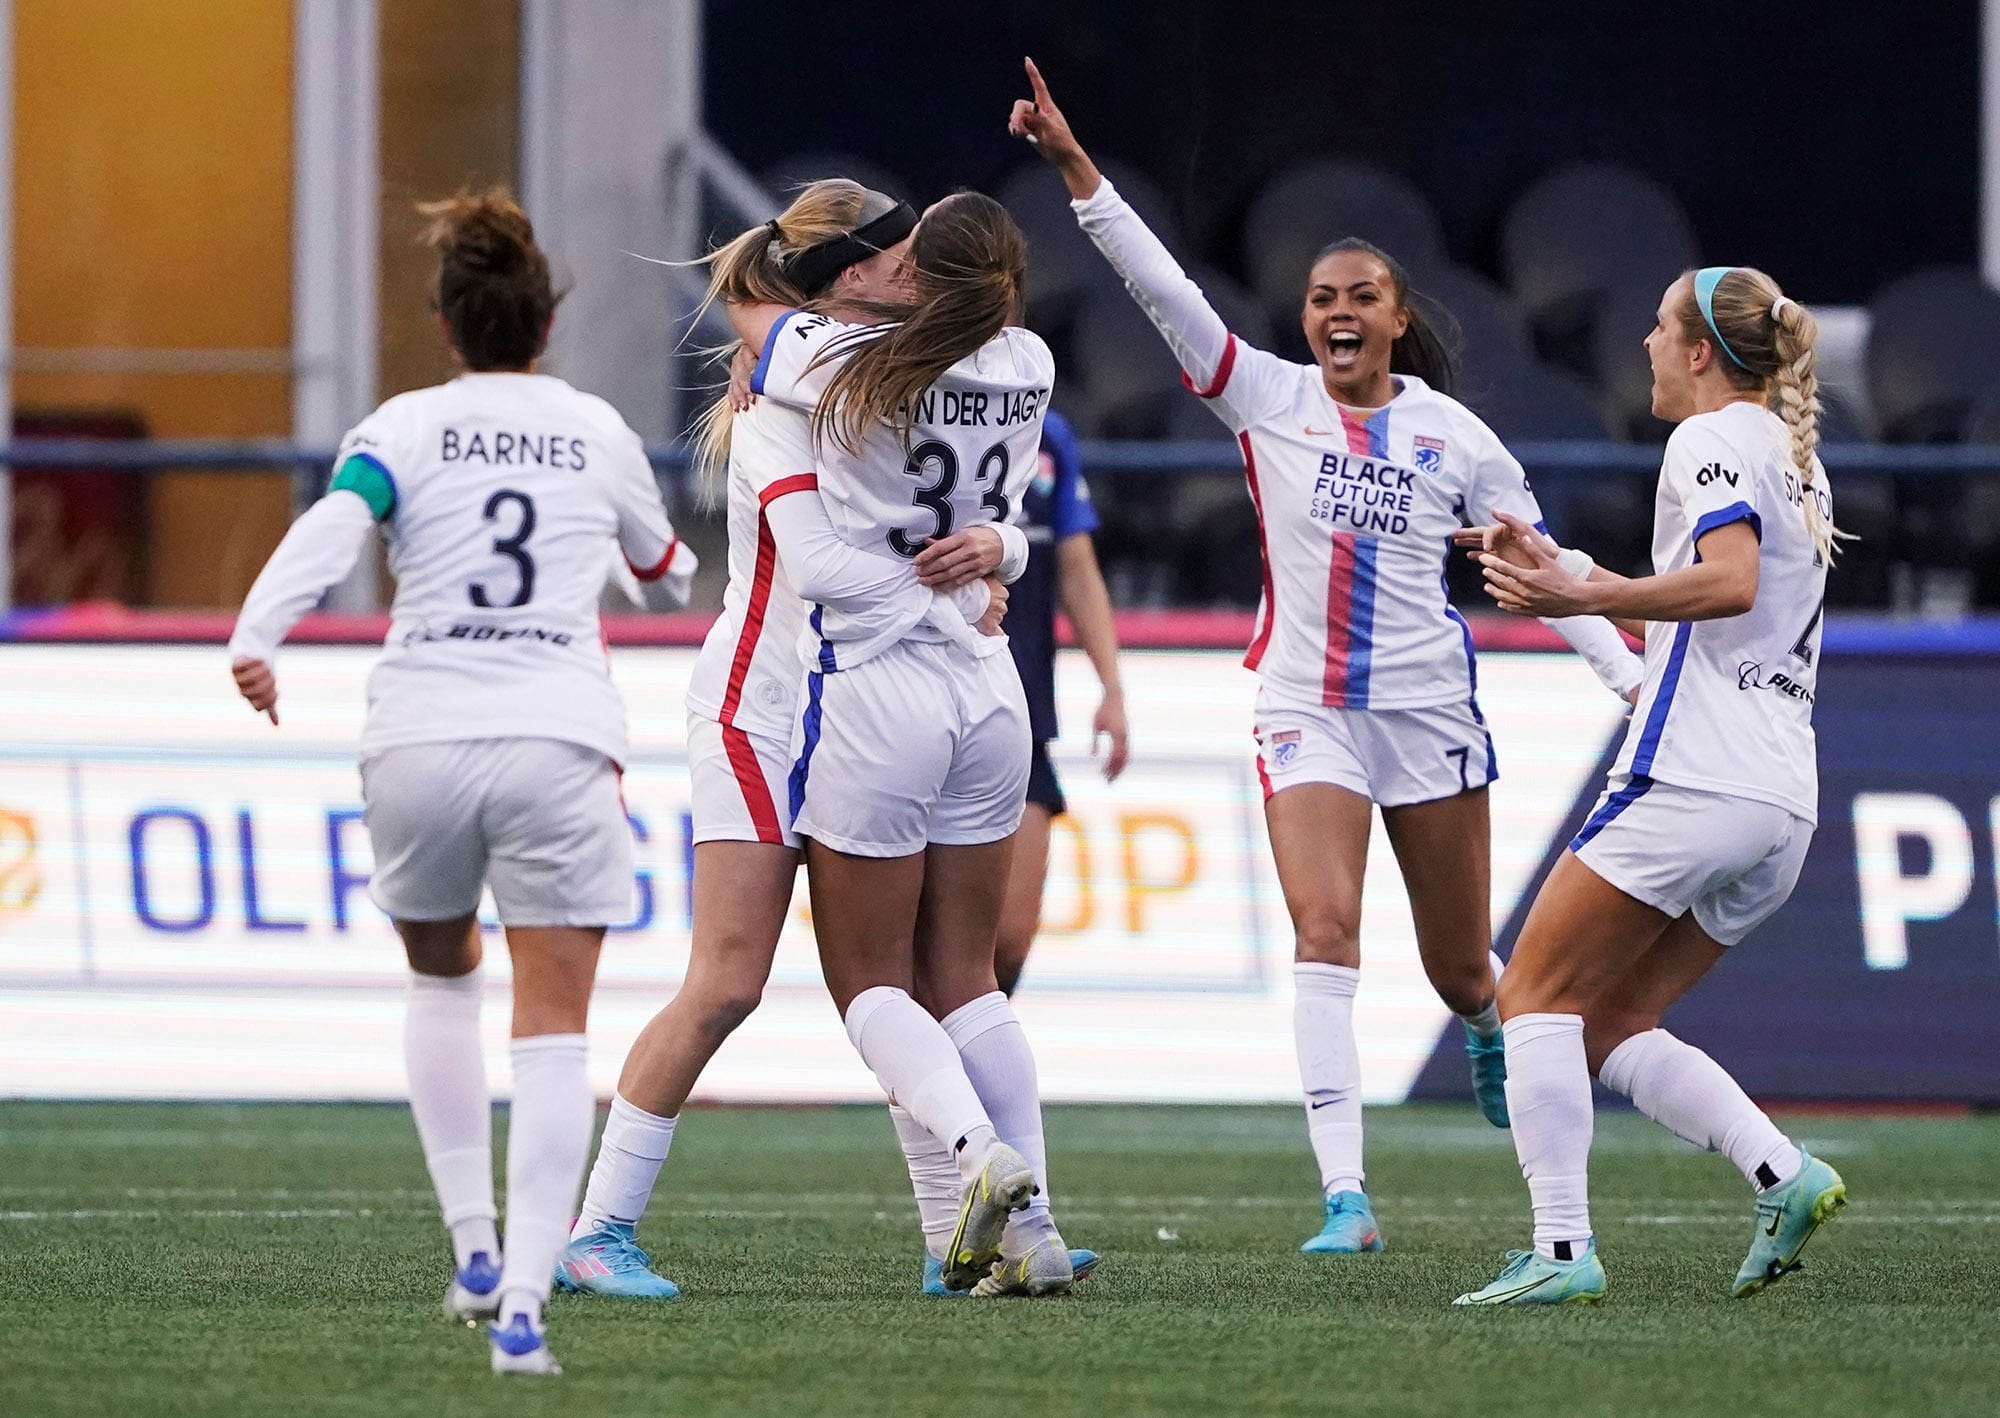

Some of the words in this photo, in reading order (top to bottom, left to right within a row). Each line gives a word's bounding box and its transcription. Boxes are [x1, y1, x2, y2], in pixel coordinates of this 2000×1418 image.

[943, 391, 988, 426] DER
[996, 388, 1049, 426] JAGT
[441, 429, 586, 472] BARNES
[1319, 453, 1416, 492] BLACK
[886, 439, 1010, 558] 33
[1314, 478, 1413, 513] FUTURE
[1331, 503, 1408, 535] FUND
[468, 488, 537, 608] 3
[1445, 745, 1470, 790] 7
